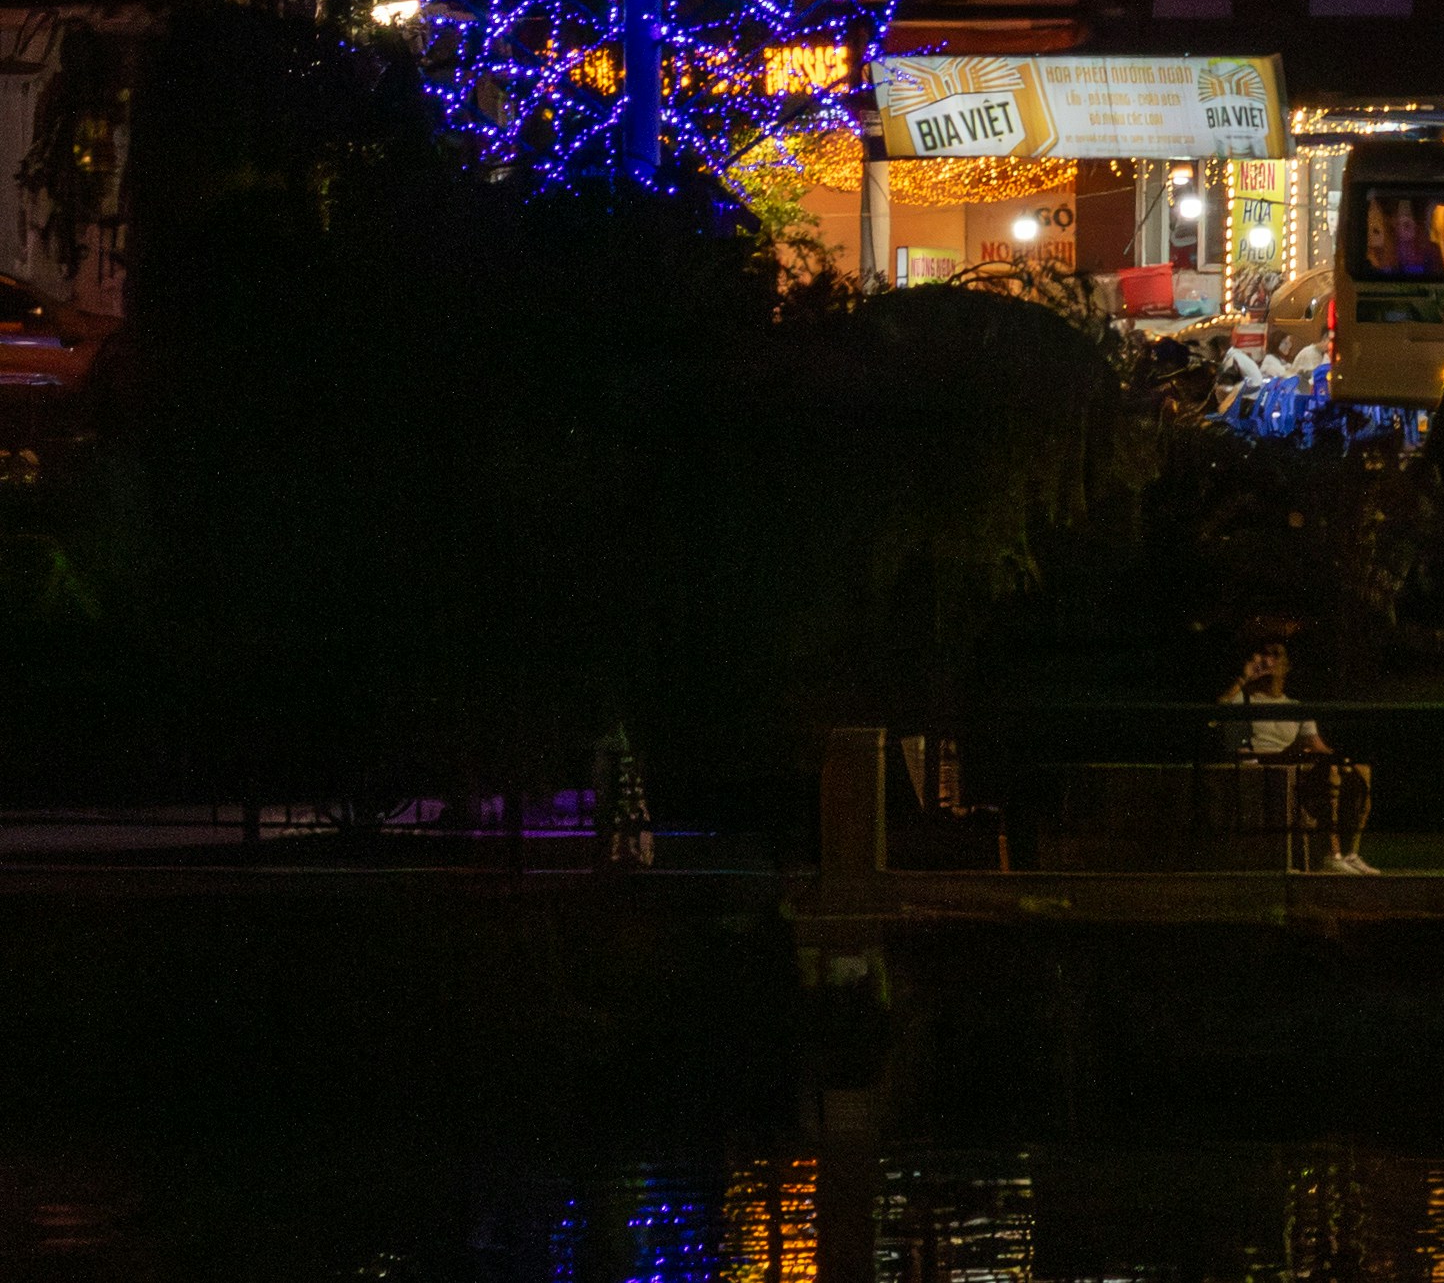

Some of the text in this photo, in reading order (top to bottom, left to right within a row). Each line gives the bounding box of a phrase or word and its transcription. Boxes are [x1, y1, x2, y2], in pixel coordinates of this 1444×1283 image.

[915, 98, 1014, 152] BIA VIỆT
[1206, 102, 1265, 131] BIA VIỆT
